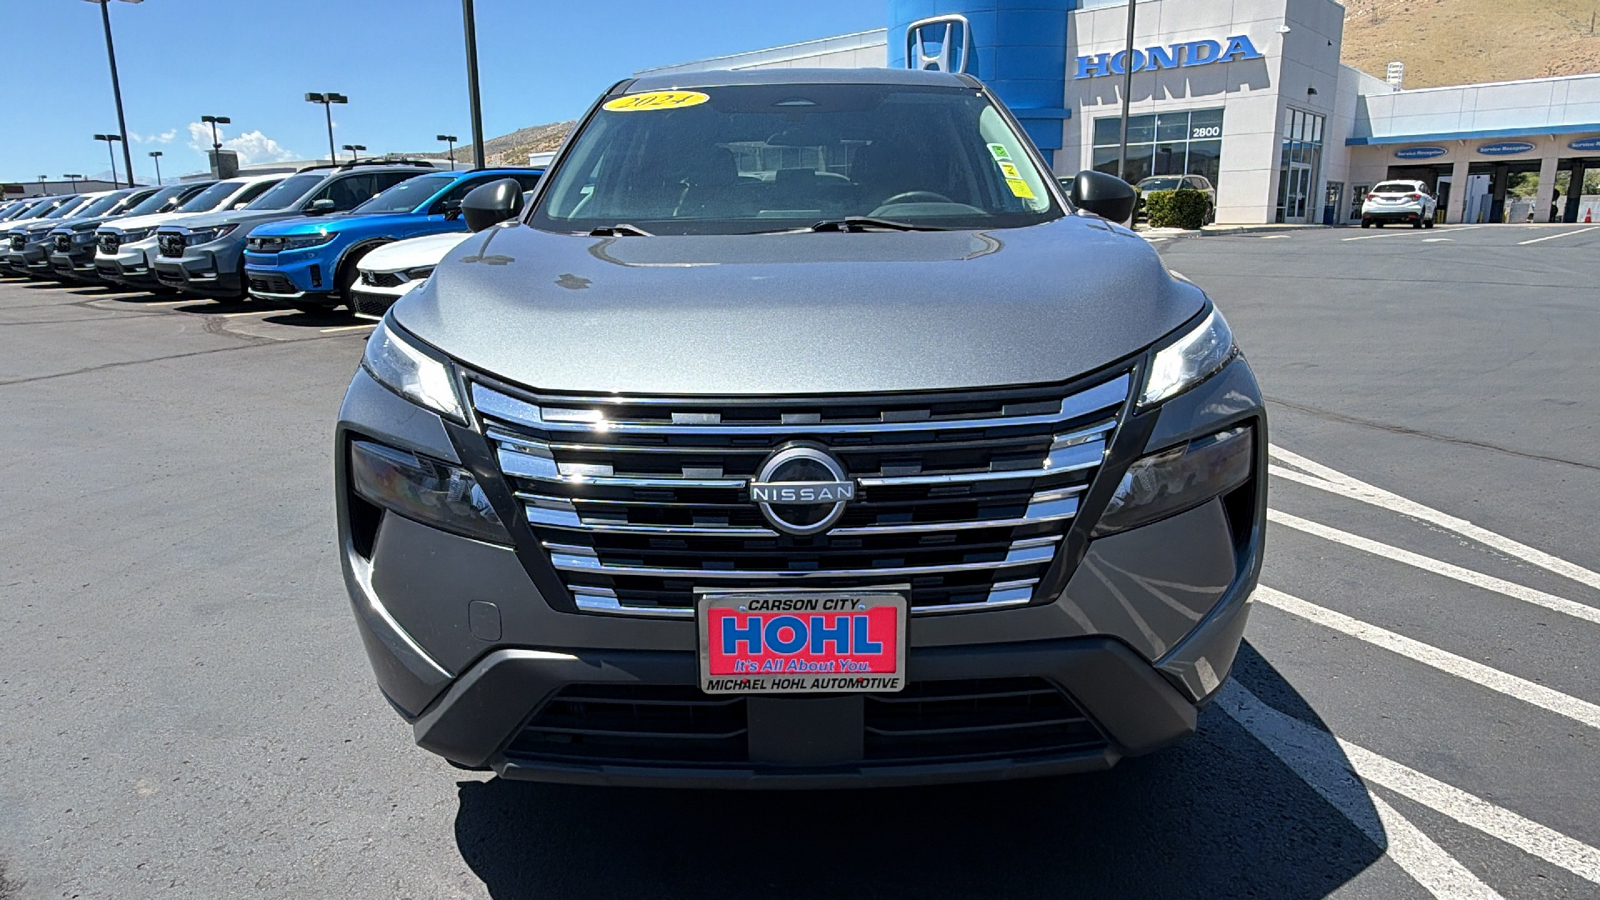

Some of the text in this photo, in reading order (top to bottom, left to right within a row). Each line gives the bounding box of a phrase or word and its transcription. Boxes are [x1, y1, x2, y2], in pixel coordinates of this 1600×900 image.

[1073, 34, 1263, 80] HONDA
[616, 94, 695, 109] 2024
[1192, 126, 1220, 138] 2800
[753, 486, 852, 501] NISSAN
[748, 598, 860, 611] CARSON CITY
[721, 615, 883, 655] HOHL
[734, 659, 871, 672] It's All About You.
[706, 677, 900, 691] MICHAEL HOHL AUTOMOTIVE
